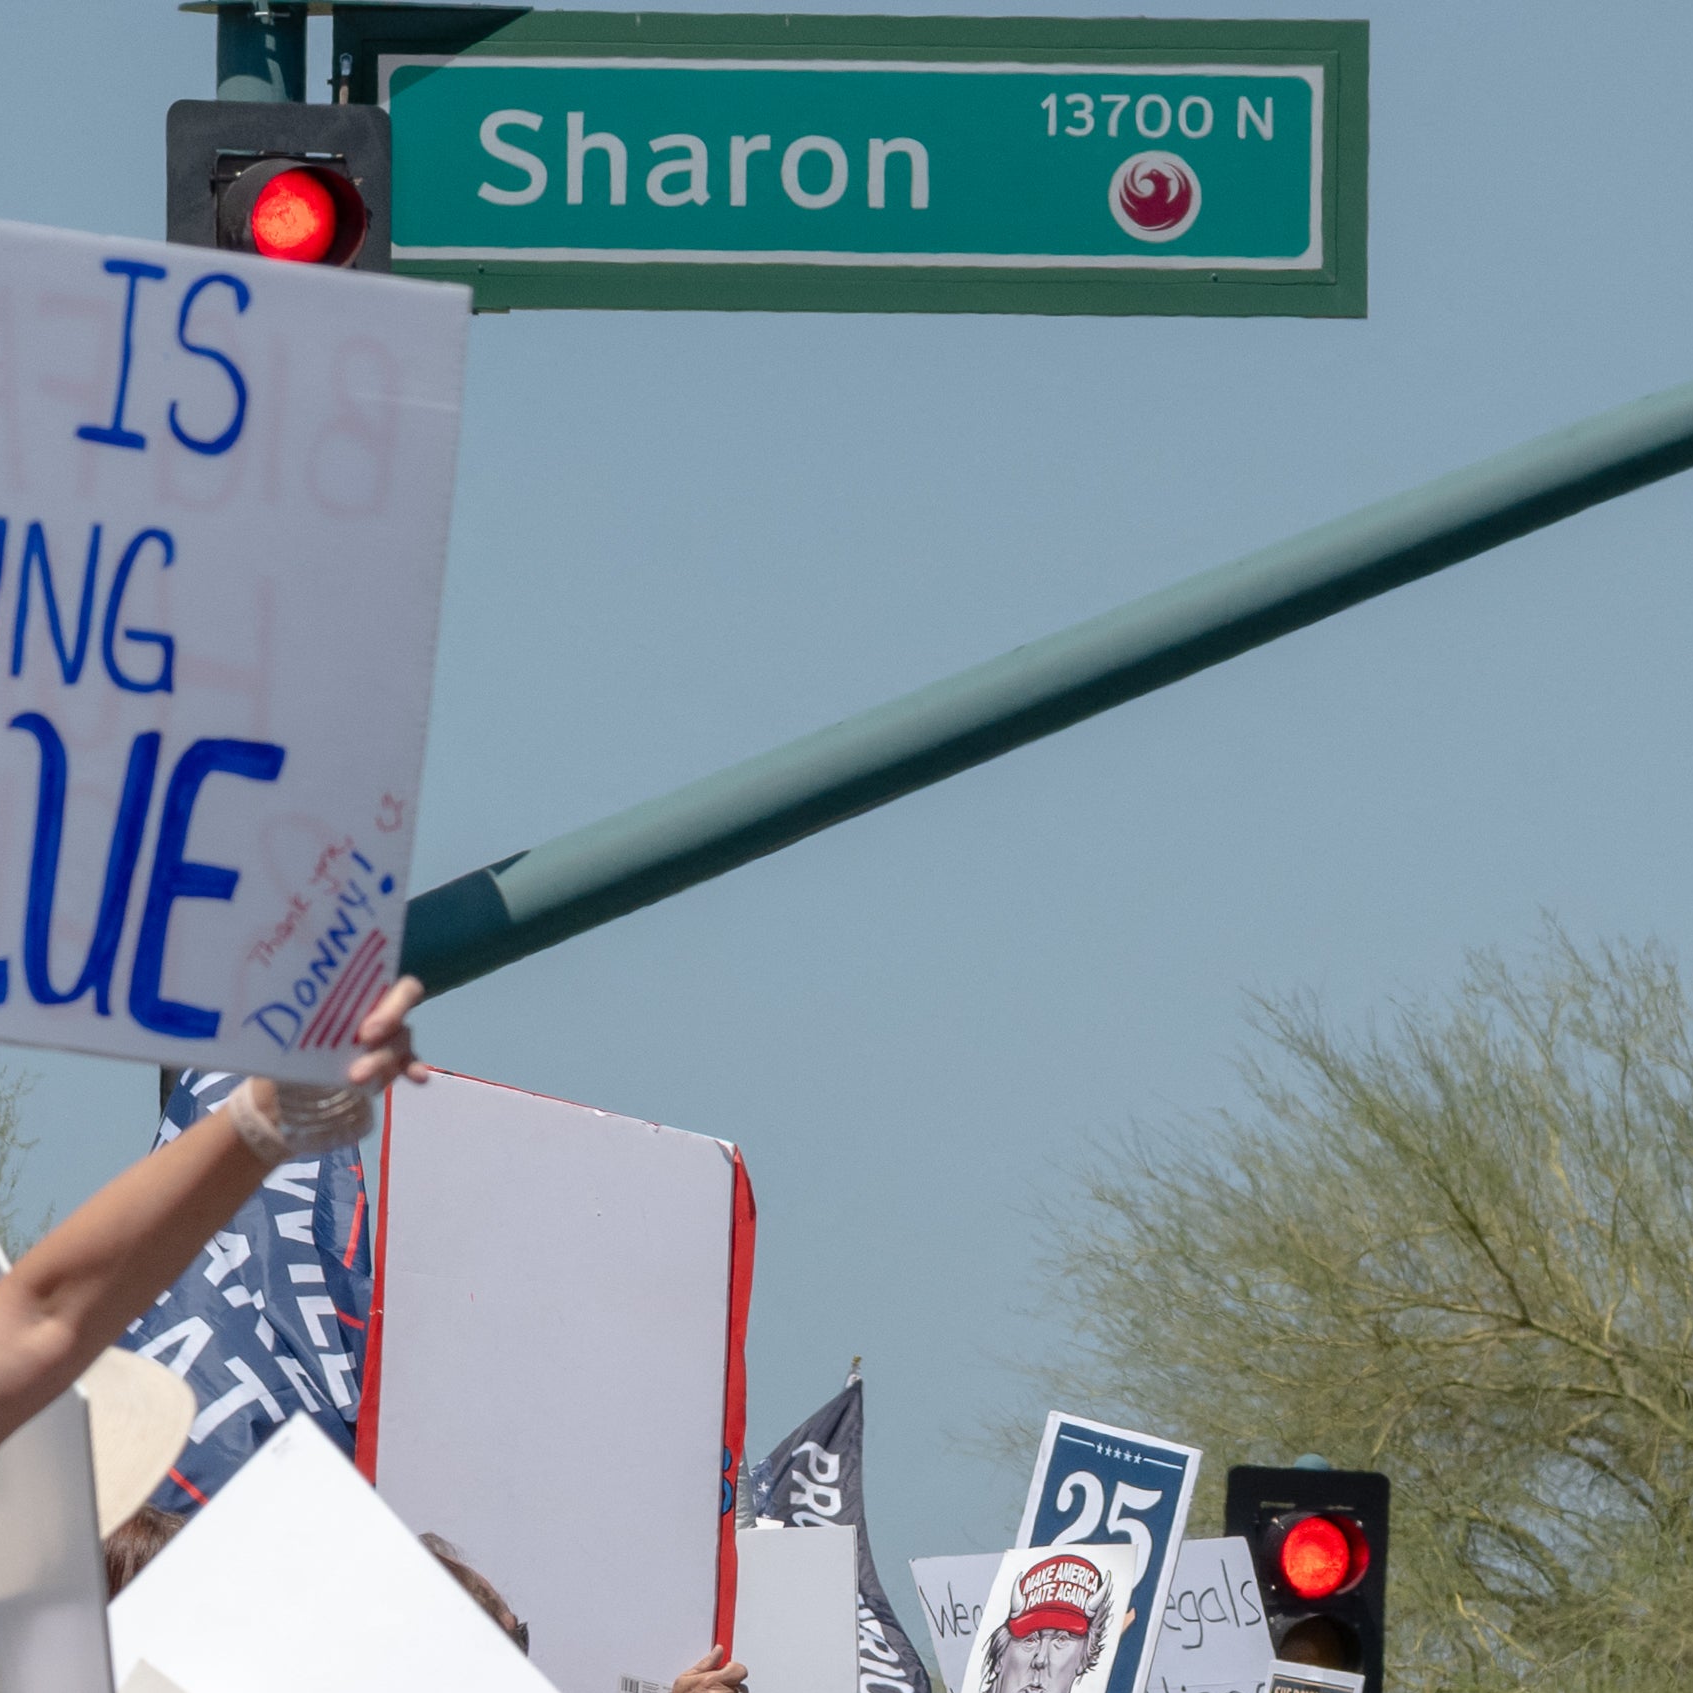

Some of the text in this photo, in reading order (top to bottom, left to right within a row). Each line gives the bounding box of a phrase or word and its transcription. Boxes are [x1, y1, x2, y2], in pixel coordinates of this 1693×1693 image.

[477, 108, 929, 209] Sharon
[1039, 93, 1274, 140] 13700 N
[76, 257, 251, 457] IS
[1056, 1470, 1163, 1592] 25
[1023, 1562, 1100, 1595] MAKE AMERICA
[1025, 1584, 1055, 1610] HATE
[1161, 1558, 1262, 1650] egals
